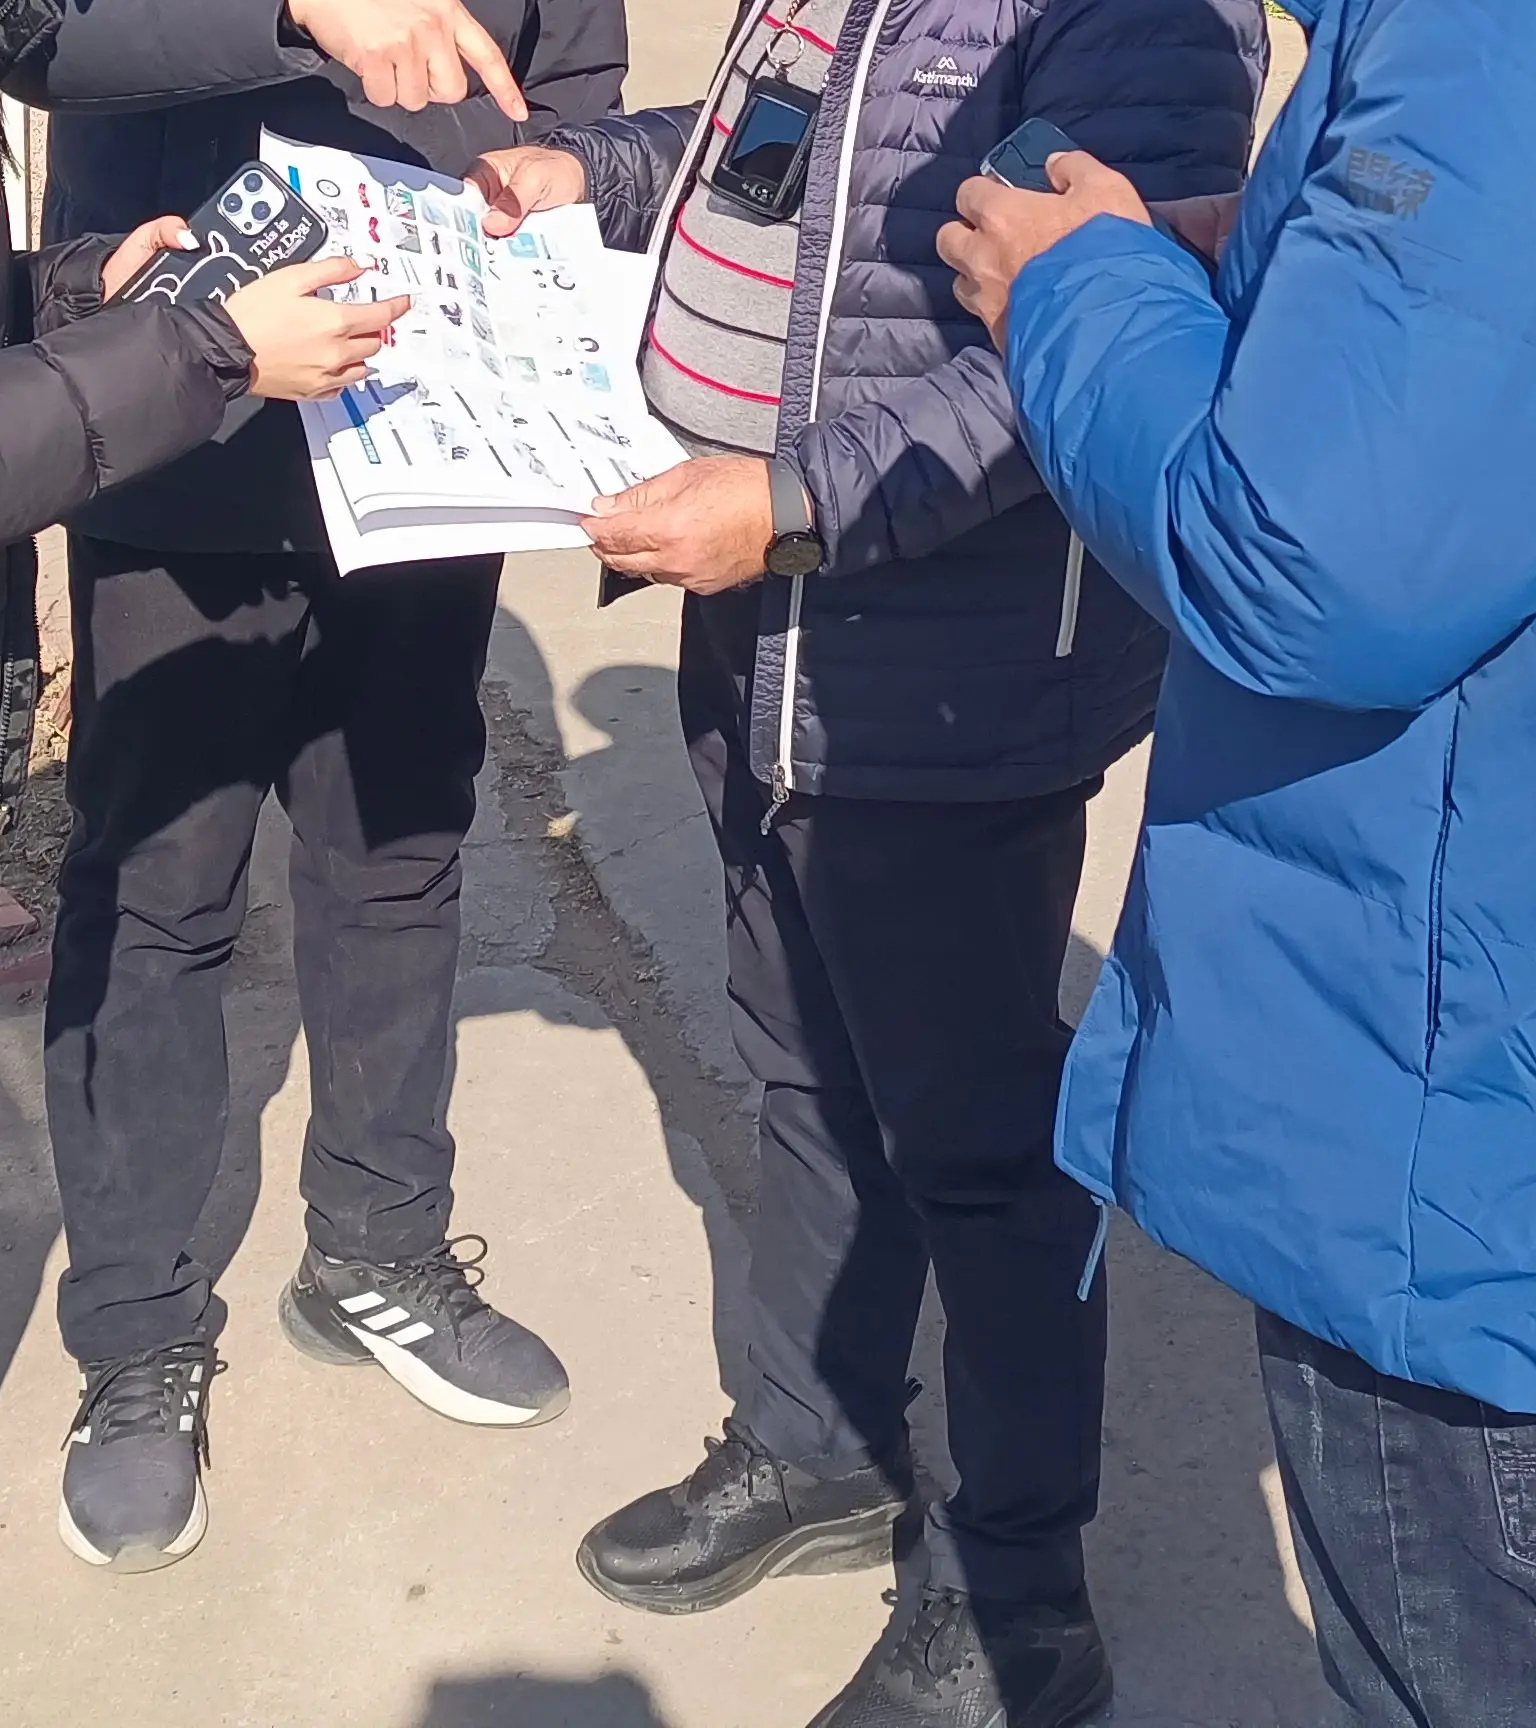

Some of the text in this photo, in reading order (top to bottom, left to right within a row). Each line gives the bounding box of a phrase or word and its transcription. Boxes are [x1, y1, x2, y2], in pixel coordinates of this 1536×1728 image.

[913, 68, 978, 88] Kathmandu
[249, 231, 279, 255] This
[274, 219, 290, 233] is
[260, 246, 285, 270] My
[280, 215, 313, 248] Dog!
